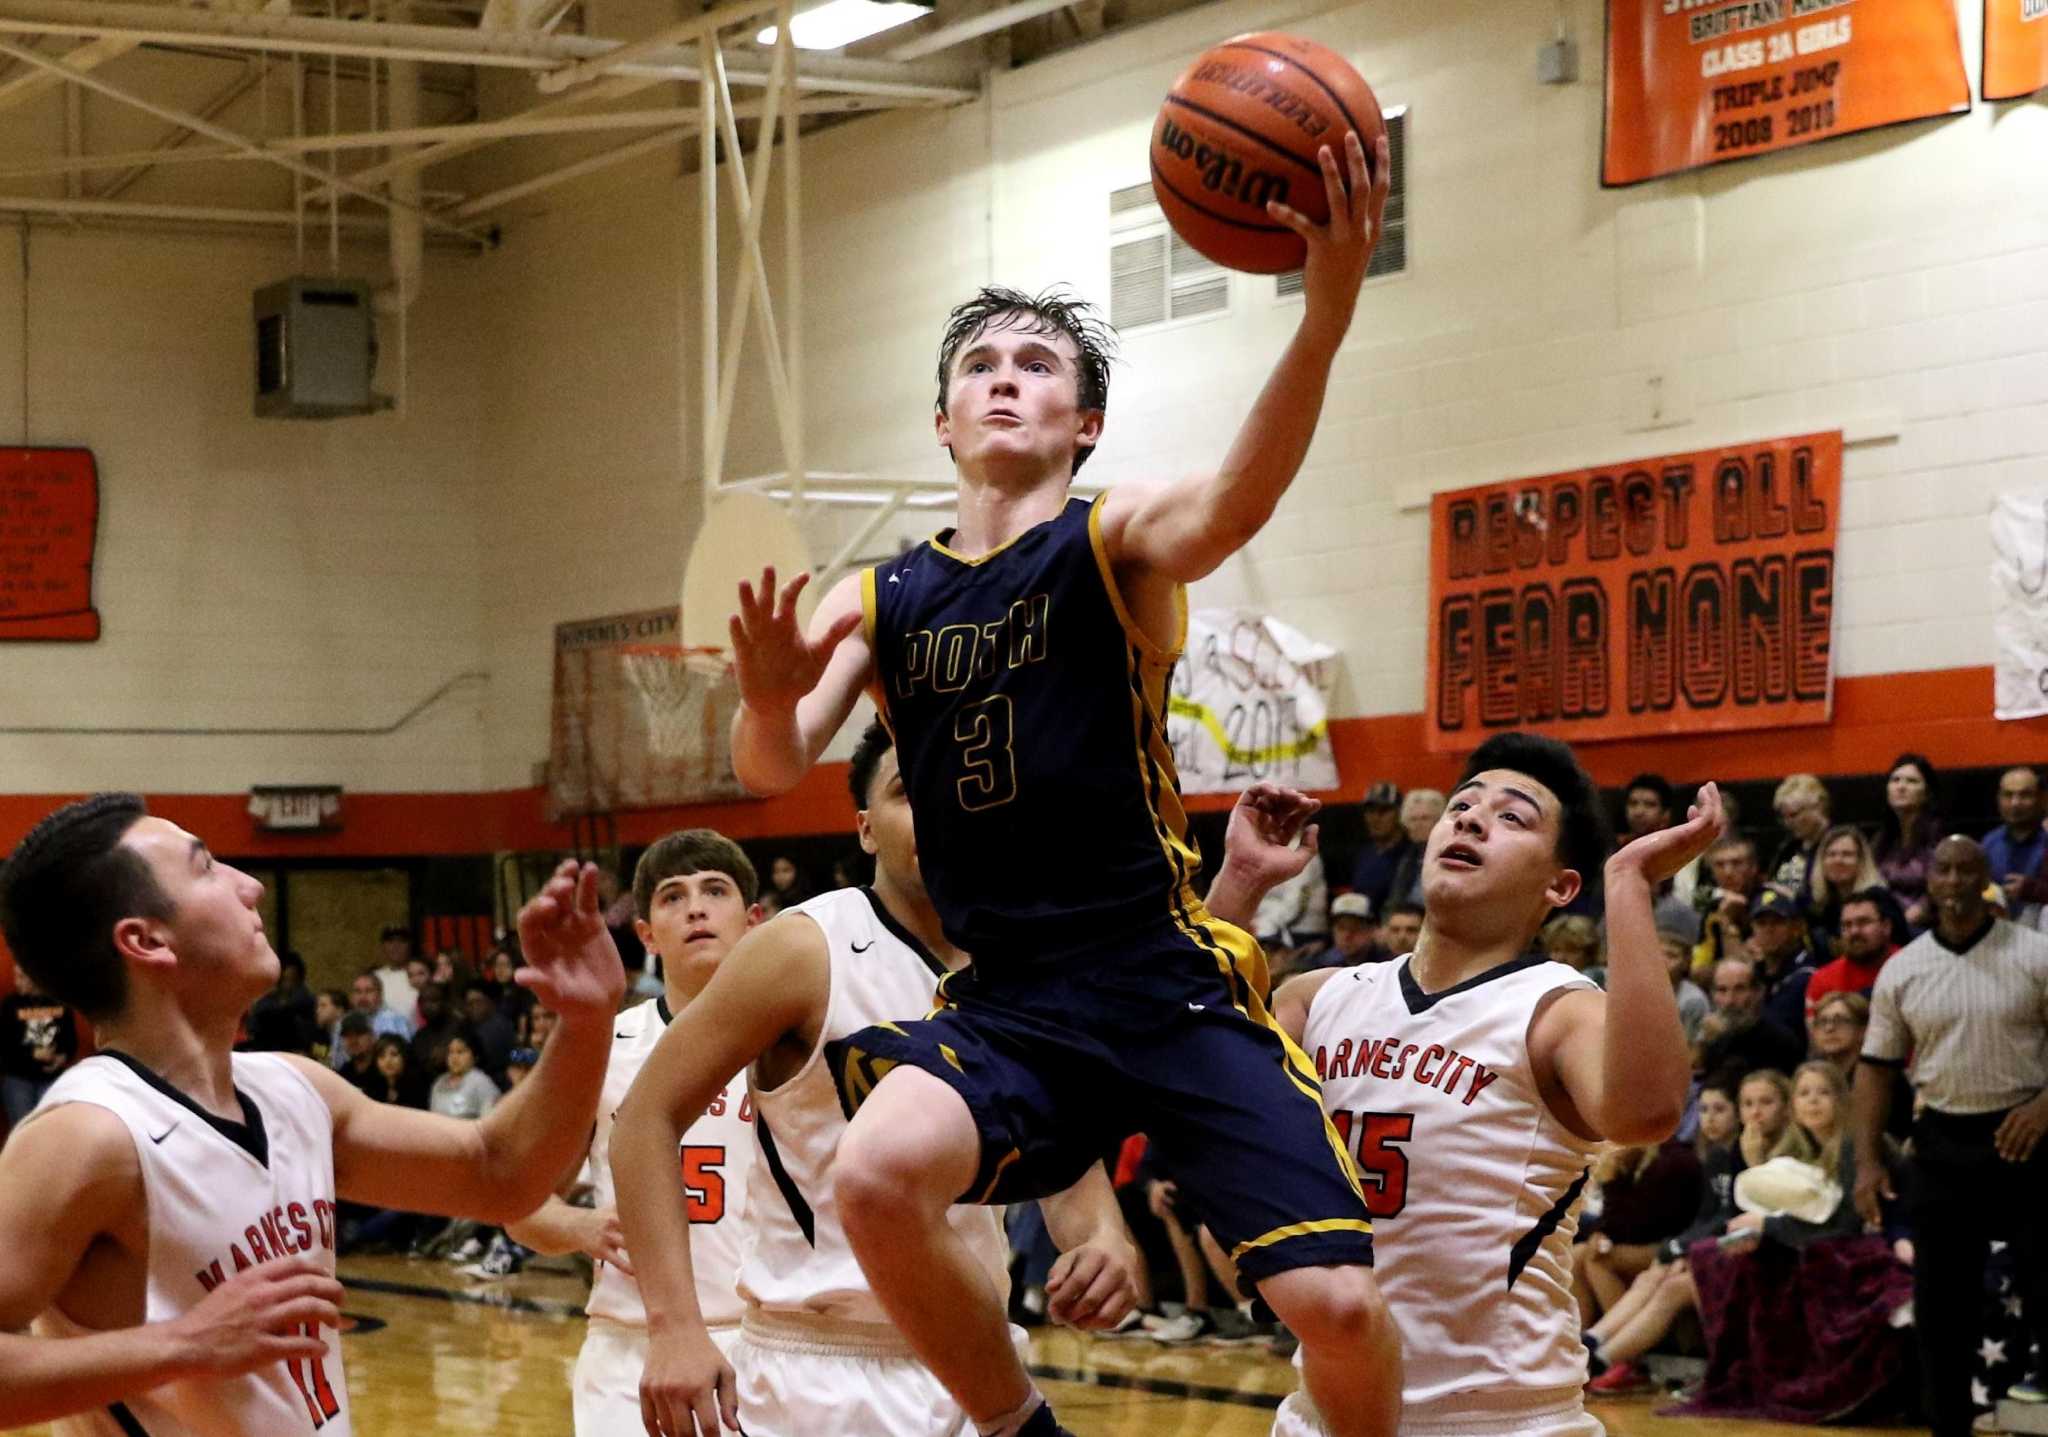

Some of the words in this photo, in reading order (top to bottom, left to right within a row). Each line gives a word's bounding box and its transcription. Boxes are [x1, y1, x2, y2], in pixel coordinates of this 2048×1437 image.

[1701, 39, 1765, 78] CLASS
[1767, 30, 1794, 64] 2A
[1796, 14, 1852, 56] GIRLS
[1712, 76, 1783, 114] TRIPLE
[1714, 114, 1772, 152] 2008
[1160, 118, 1291, 210] Wilson
[1448, 463, 1696, 580] RESPECT
[1712, 446, 1827, 545] ALL
[896, 592, 1050, 699] POTH
[1437, 575, 1610, 732] FEAR
[1626, 549, 1835, 714] NONE
[953, 693, 1018, 813] 3
[1310, 1037, 1418, 1083] ARNES
[1413, 1043, 1499, 1107] CITY
